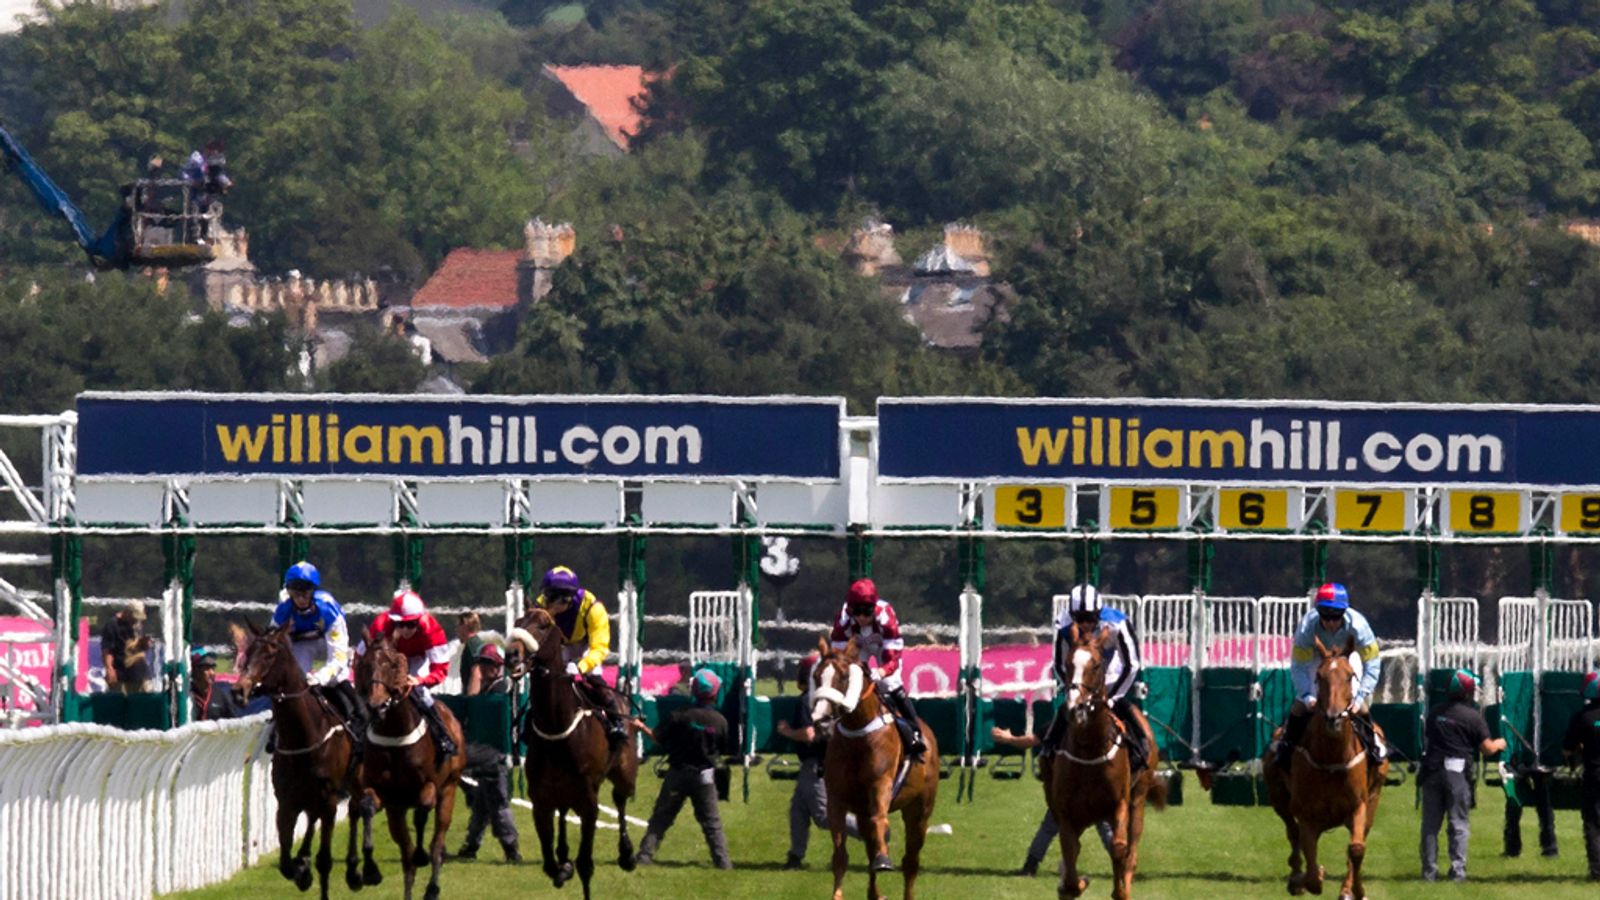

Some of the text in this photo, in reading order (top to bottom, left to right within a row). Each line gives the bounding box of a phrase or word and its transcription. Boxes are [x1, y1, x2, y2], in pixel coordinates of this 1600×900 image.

[217, 414, 703, 466] williamhill.com
[1016, 416, 1504, 472] williamhill.com
[1017, 489, 1043, 524] 3
[1130, 491, 1157, 526] 5
[1239, 493, 1265, 526] 6
[1356, 495, 1382, 528] 7
[1469, 496, 1495, 529] 8
[1581, 497, 1600, 529] 9
